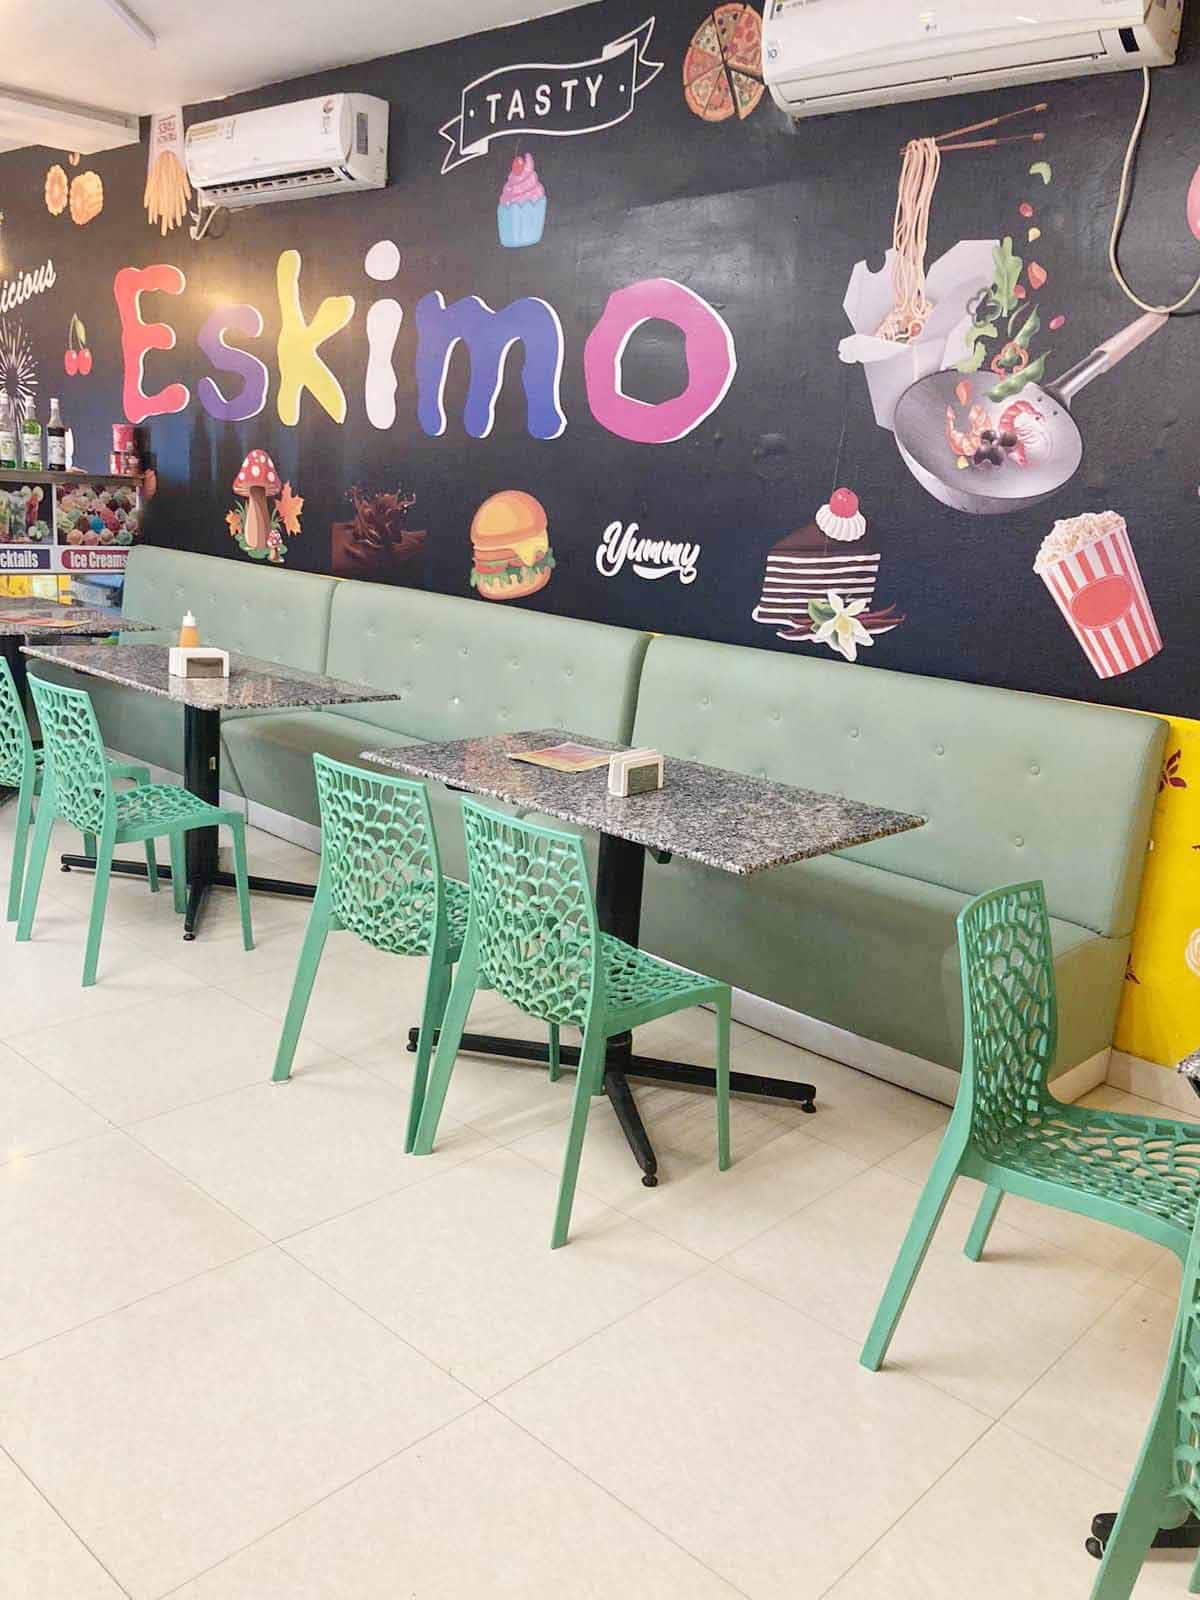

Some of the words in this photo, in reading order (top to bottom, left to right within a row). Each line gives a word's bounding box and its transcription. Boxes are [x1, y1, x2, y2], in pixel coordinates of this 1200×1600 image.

[486, 74, 603, 124] TASTY
[0, 259, 56, 314] icious
[114, 240, 737, 444] Eskimo
[0, 550, 39, 568] cktails
[70, 551, 87, 568] Ice
[595, 520, 701, 584] Yummy
